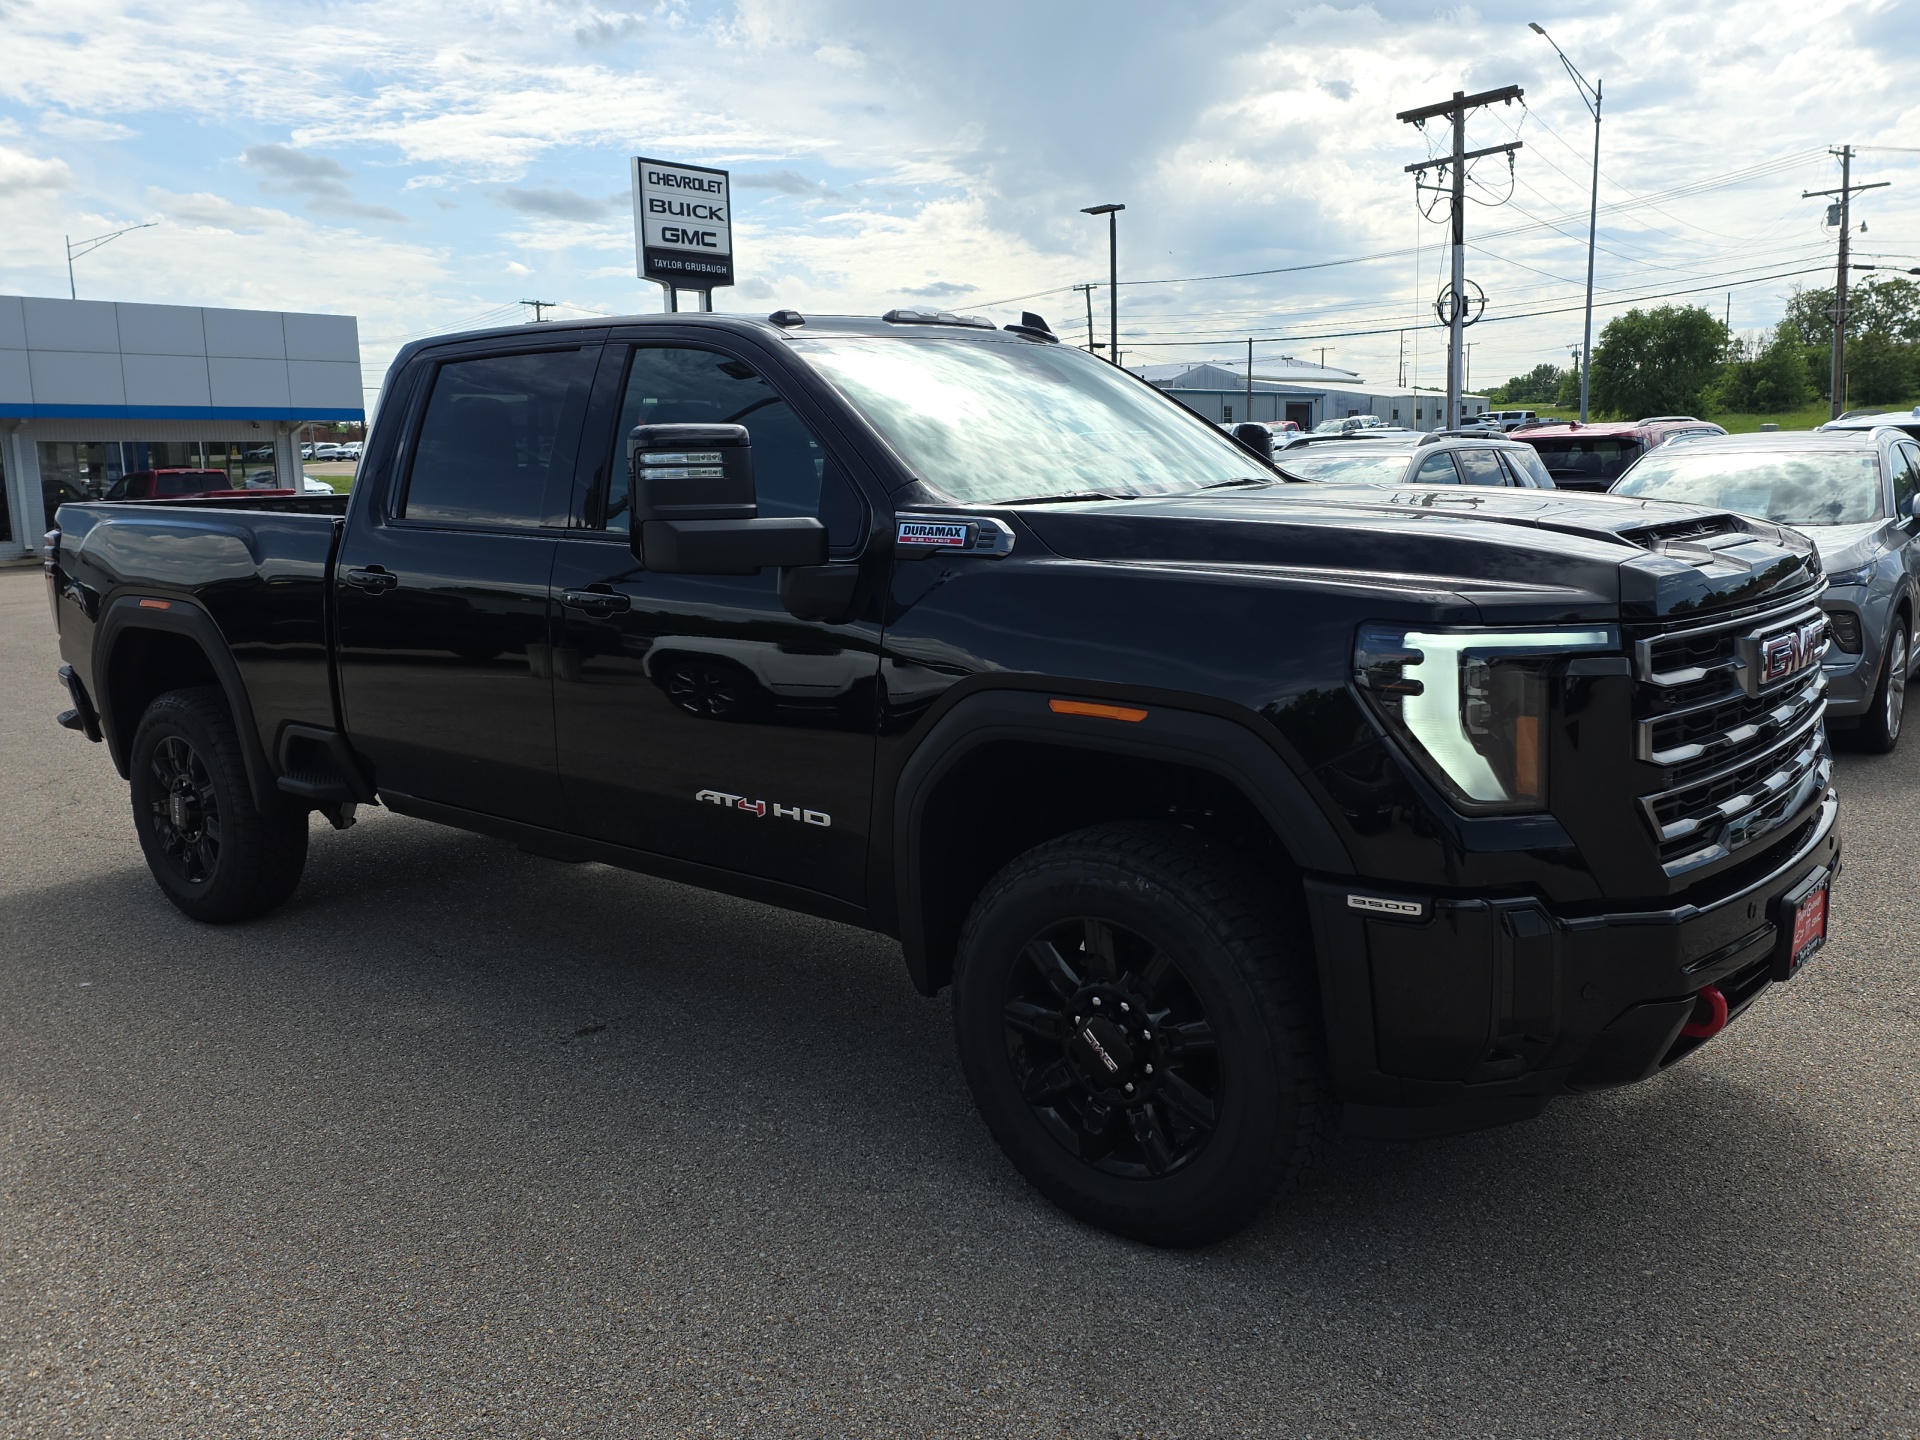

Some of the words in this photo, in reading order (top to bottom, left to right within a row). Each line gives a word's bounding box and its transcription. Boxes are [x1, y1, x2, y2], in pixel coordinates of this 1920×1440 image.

[648, 171, 723, 194] CHEVROLET
[649, 198, 725, 222] BUICK
[661, 226, 717, 248] GMC
[654, 258, 683, 270] TAYLOR
[685, 261, 727, 274] GRUBAUGH
[903, 525, 962, 537] DURAMAX
[1759, 619, 1825, 685] GMC
[695, 789, 766, 818] AT4
[773, 803, 832, 827] HD
[1351, 898, 1417, 912] 3500
[1083, 1028, 1119, 1073] GMC
